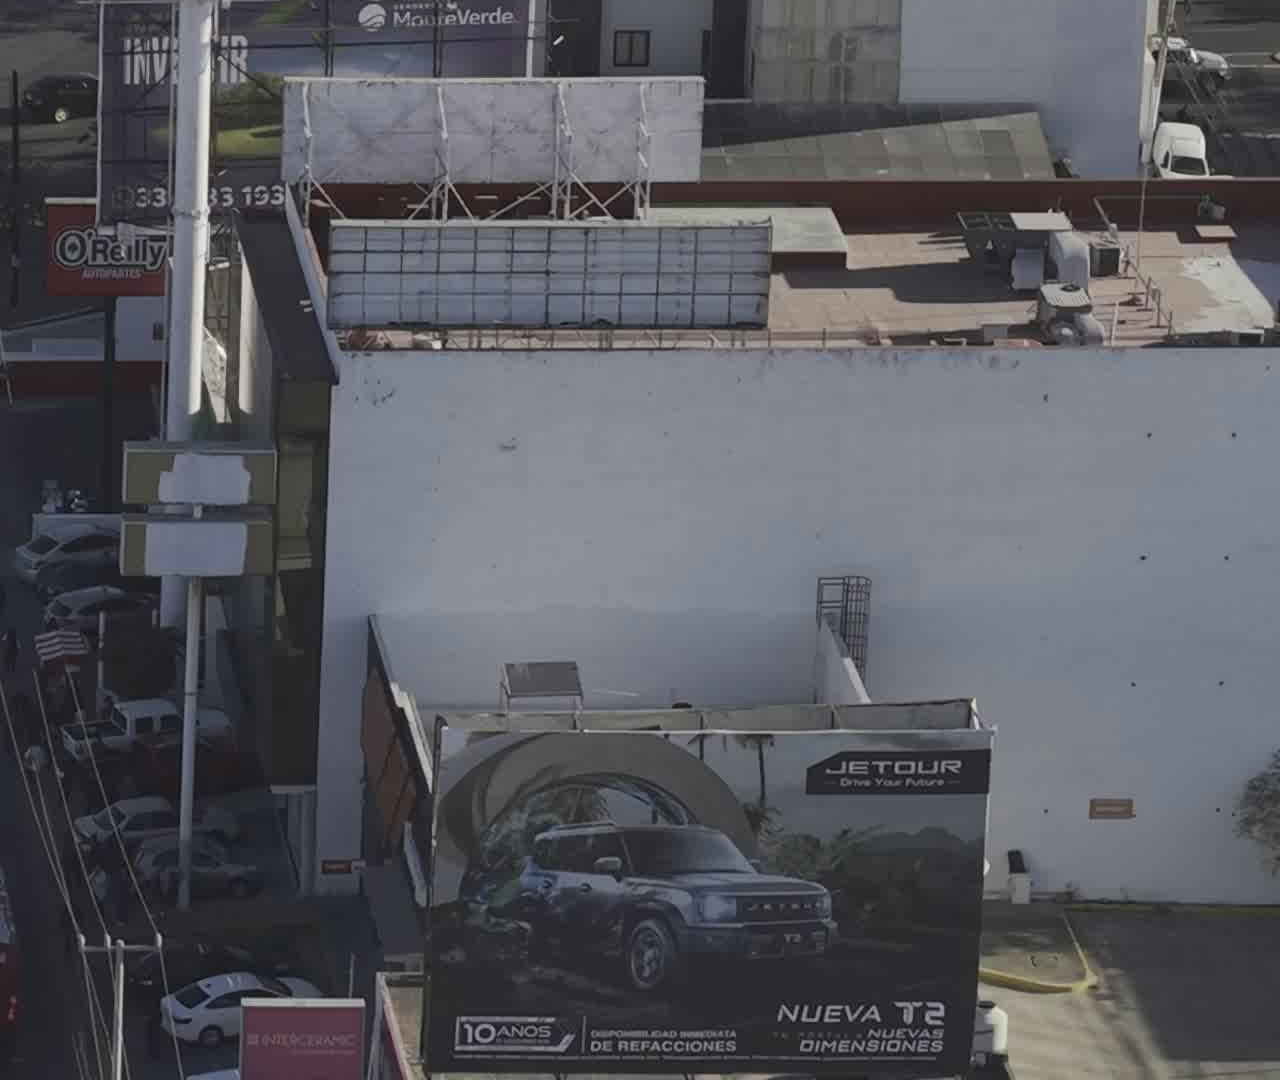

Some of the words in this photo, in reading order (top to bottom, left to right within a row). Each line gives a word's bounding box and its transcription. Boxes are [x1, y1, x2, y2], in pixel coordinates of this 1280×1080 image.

[55, 228, 168, 271] O'Reilly
[825, 760, 962, 775] JETOUR
[905, 777, 945, 787] Future
[777, 1004, 881, 1023] NUEVA
[893, 1001, 945, 1026] T2
[463, 1022, 495, 1044] 10
[496, 1023, 552, 1037] AÑOS
[866, 1028, 944, 1039] NUEVAS
[590, 1041, 612, 1053] DE
[618, 1040, 737, 1053] REFACCIONES
[799, 1040, 944, 1054] DIMENSIONES
